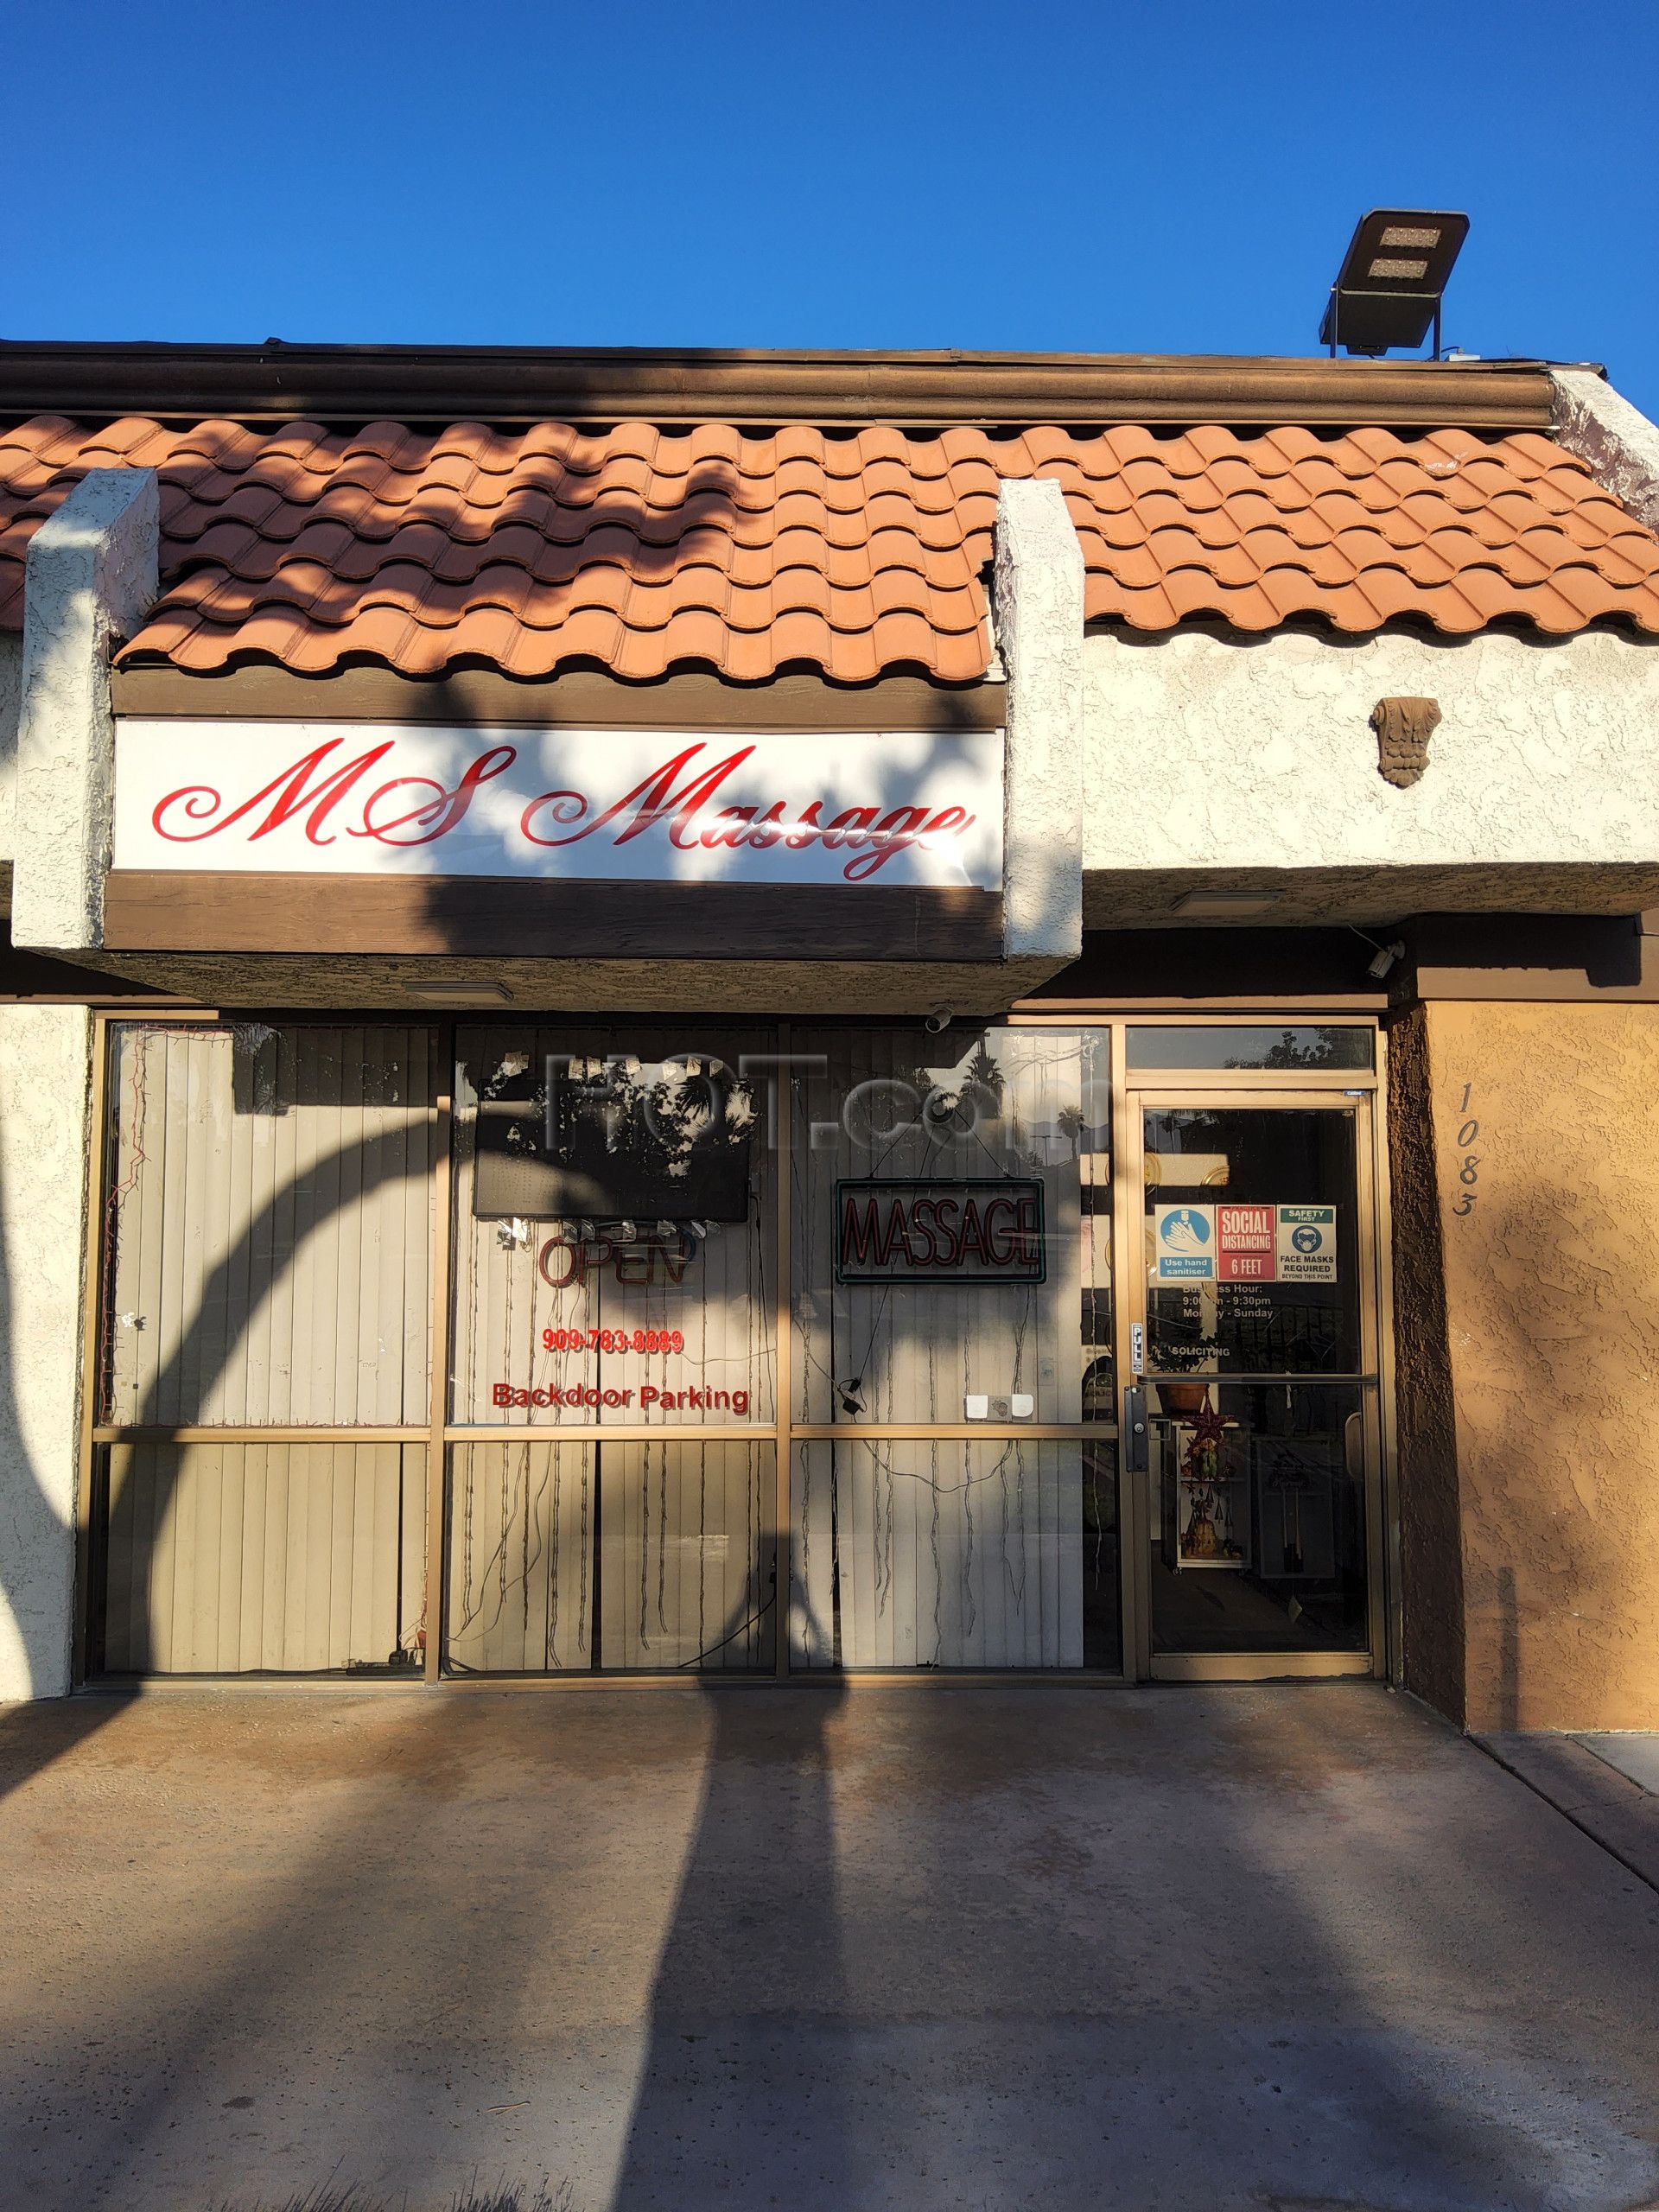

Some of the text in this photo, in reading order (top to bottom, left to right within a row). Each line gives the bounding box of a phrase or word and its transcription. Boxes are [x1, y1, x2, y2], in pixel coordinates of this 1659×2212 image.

[151, 737, 976, 881] MS Massage
[1452, 1082, 1481, 1216] 1083
[842, 1198, 1039, 1266] MASSAGE
[1222, 1211, 1270, 1234] SOCIAL
[1222, 1235, 1271, 1249] DISTANCING
[539, 1236, 688, 1288] OPEN
[1231, 1259, 1262, 1274] 6 FEET
[1183, 1284, 1262, 1294] Busess Hour:
[1182, 1296, 1224, 1306] 9:00m
[1232, 1296, 1271, 1306] 9:30pm
[1183, 1309, 1224, 1319] Mony
[1234, 1308, 1273, 1319] Sunday
[543, 1328, 683, 1353] 909-783-8889
[1172, 1346, 1230, 1357] SOLICITING
[493, 1383, 748, 1414] Backdoor Parking
